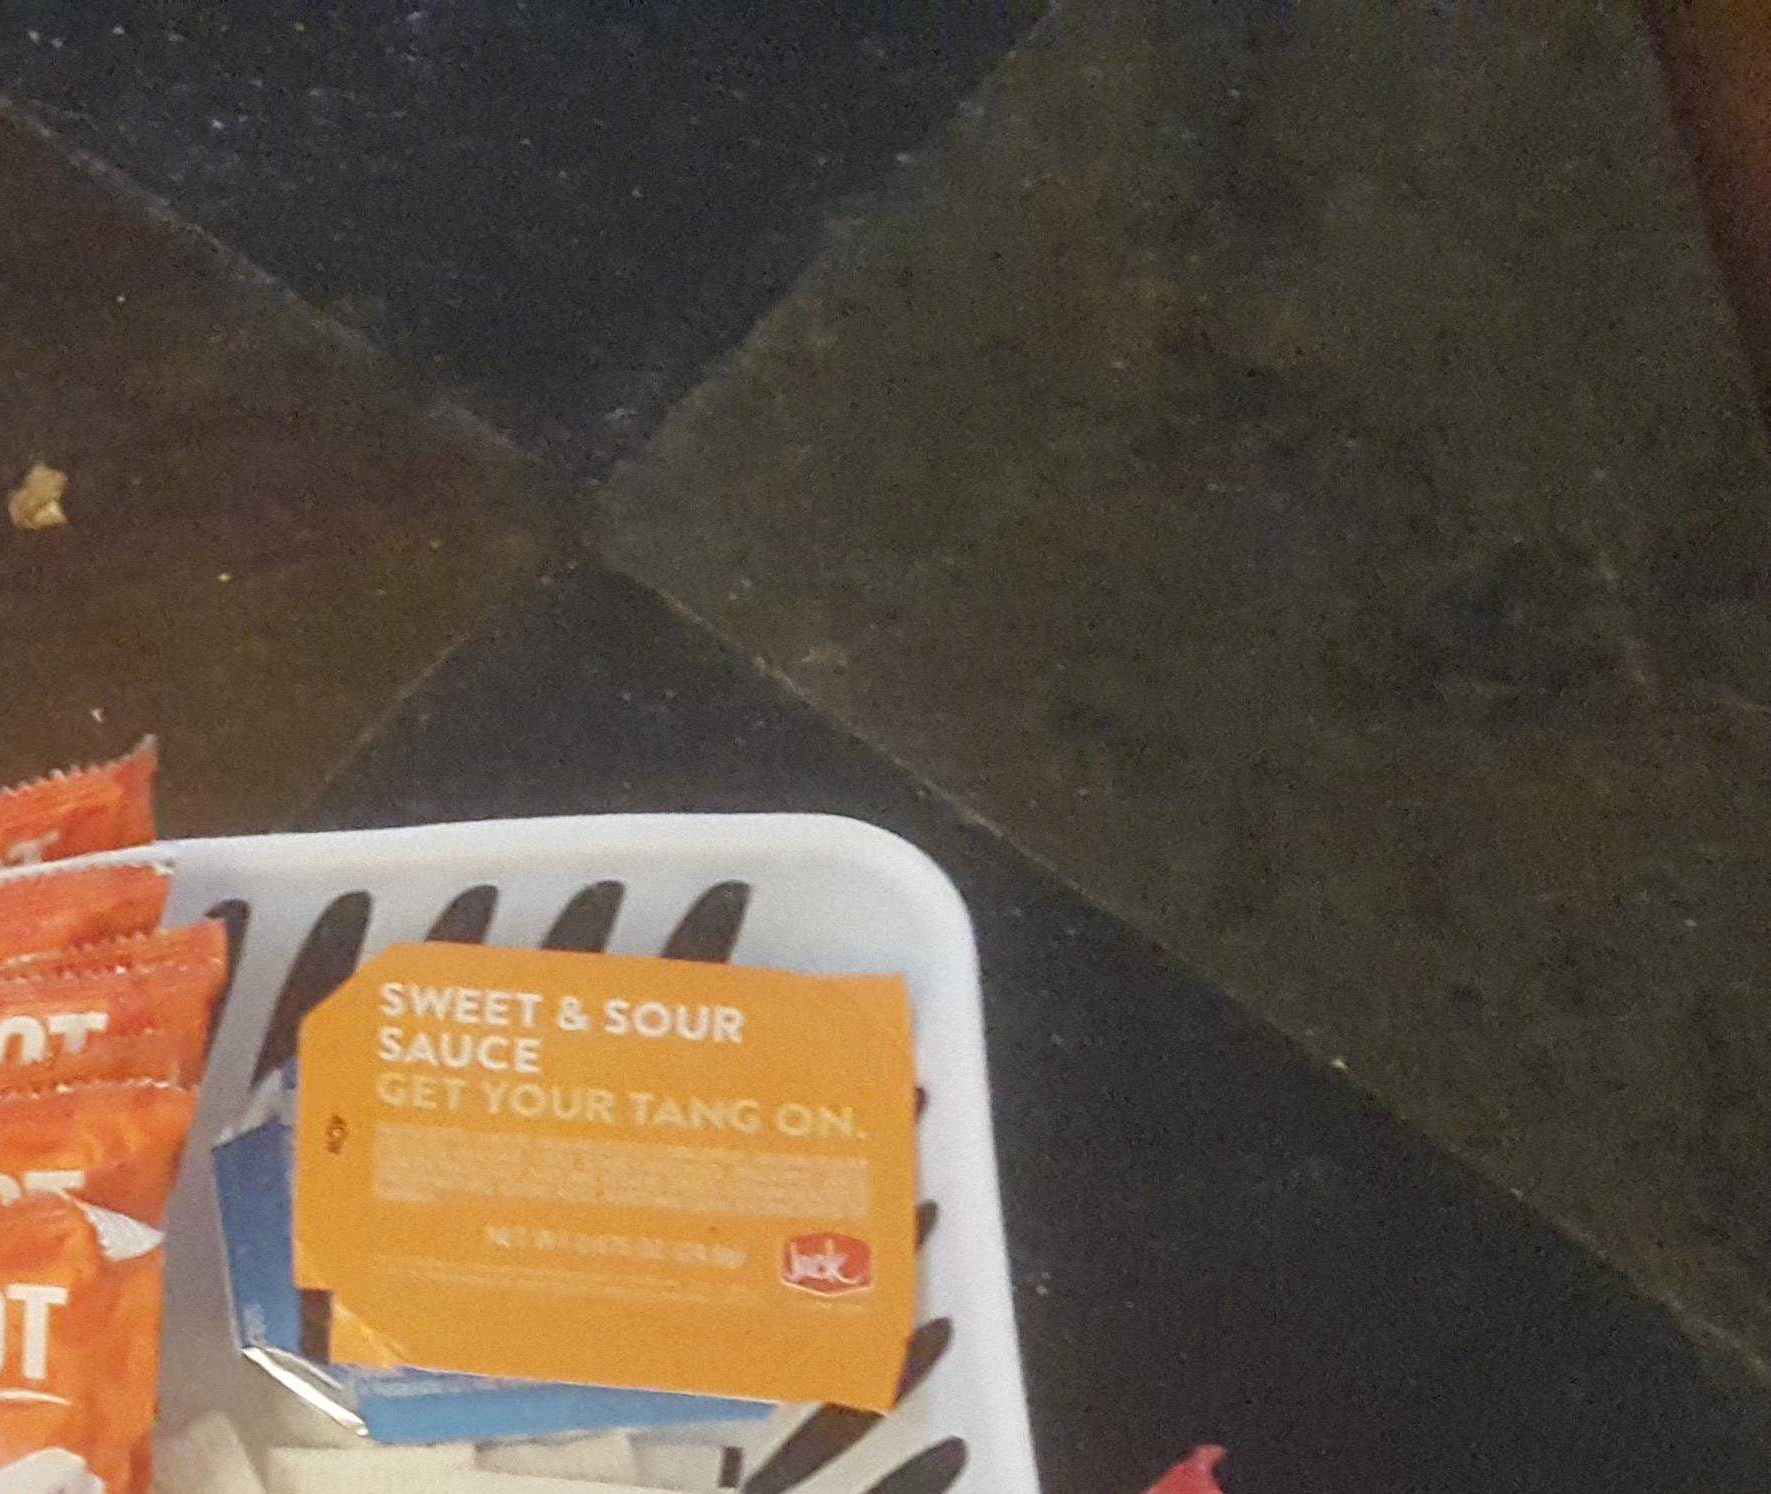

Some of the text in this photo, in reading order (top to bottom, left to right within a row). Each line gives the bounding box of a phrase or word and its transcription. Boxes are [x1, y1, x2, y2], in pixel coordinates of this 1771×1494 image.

[379, 981, 746, 1045] SWEET & SOUR
[377, 1026, 542, 1073] SAUCE
[376, 1071, 868, 1140] GET YOUR TANG ON.
